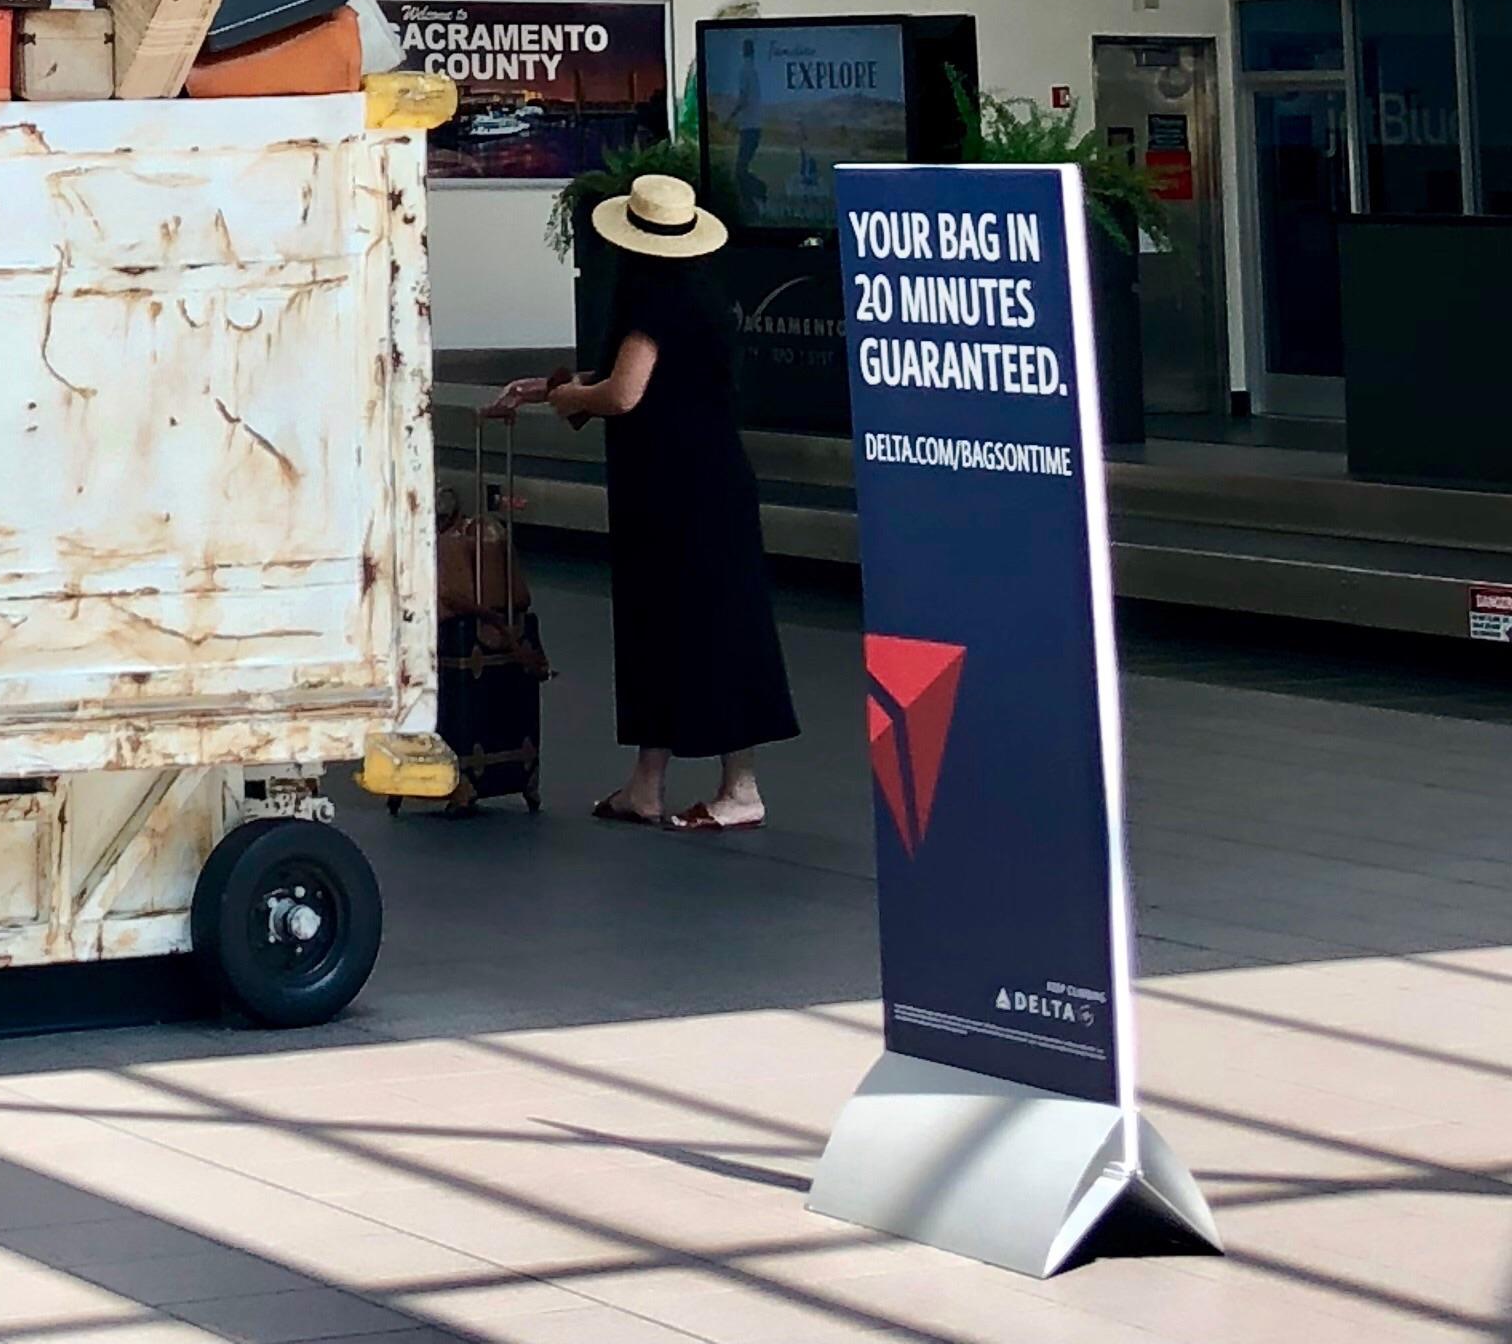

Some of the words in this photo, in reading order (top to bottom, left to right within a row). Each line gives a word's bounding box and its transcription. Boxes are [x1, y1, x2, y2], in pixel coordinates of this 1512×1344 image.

[400, 4, 454, 21] Welcome
[455, 8, 468, 21] to
[424, 52, 563, 81] COUNTY
[848, 210, 933, 260] YOUR
[937, 211, 1002, 261] BAG
[1006, 213, 1041, 263] IN
[854, 273, 893, 323] 20
[899, 275, 1036, 329] MINUTES
[859, 337, 1069, 397] GUARANTEED.
[864, 432, 1073, 477] DELTA.COM/BAGSONTIME
[1014, 991, 1076, 1023] DELTA
